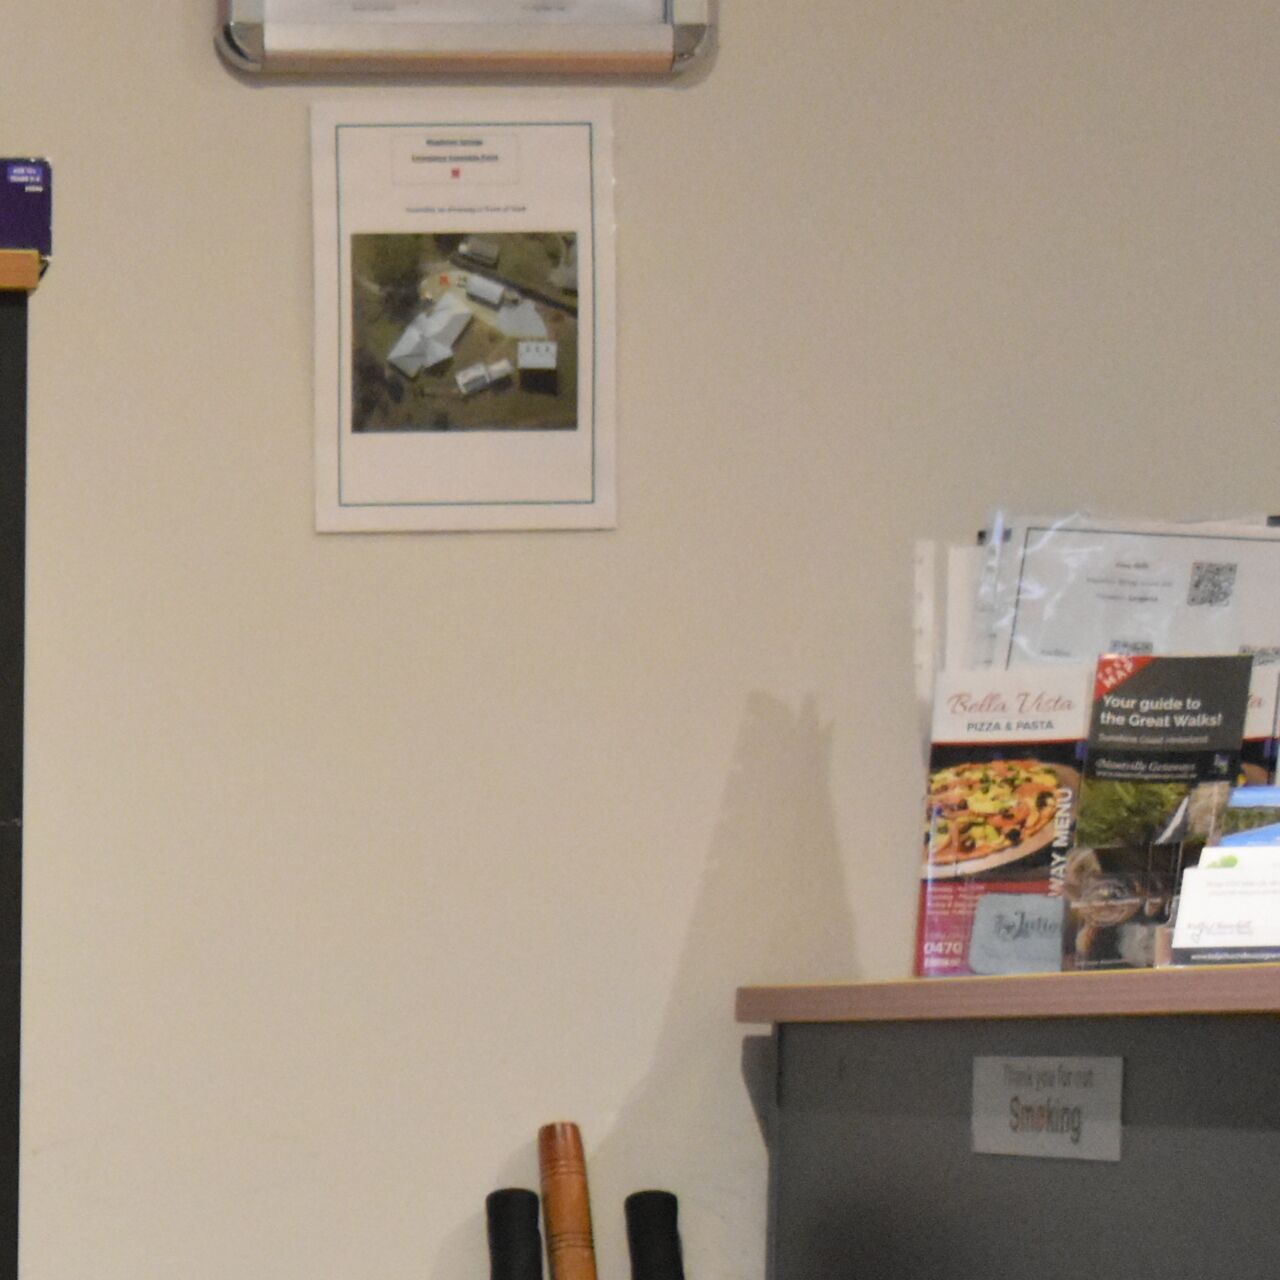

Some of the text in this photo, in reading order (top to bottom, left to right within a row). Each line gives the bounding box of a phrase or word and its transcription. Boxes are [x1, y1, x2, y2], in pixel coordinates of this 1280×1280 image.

[947, 691, 1012, 714] Bella
[1103, 696, 1201, 712] Your guide to
[967, 721, 1001, 732] PIZZA
[1016, 720, 1054, 731] PASTA
[1100, 712, 1223, 727] the Great Walks!
[1054, 788, 1073, 849] MENU
